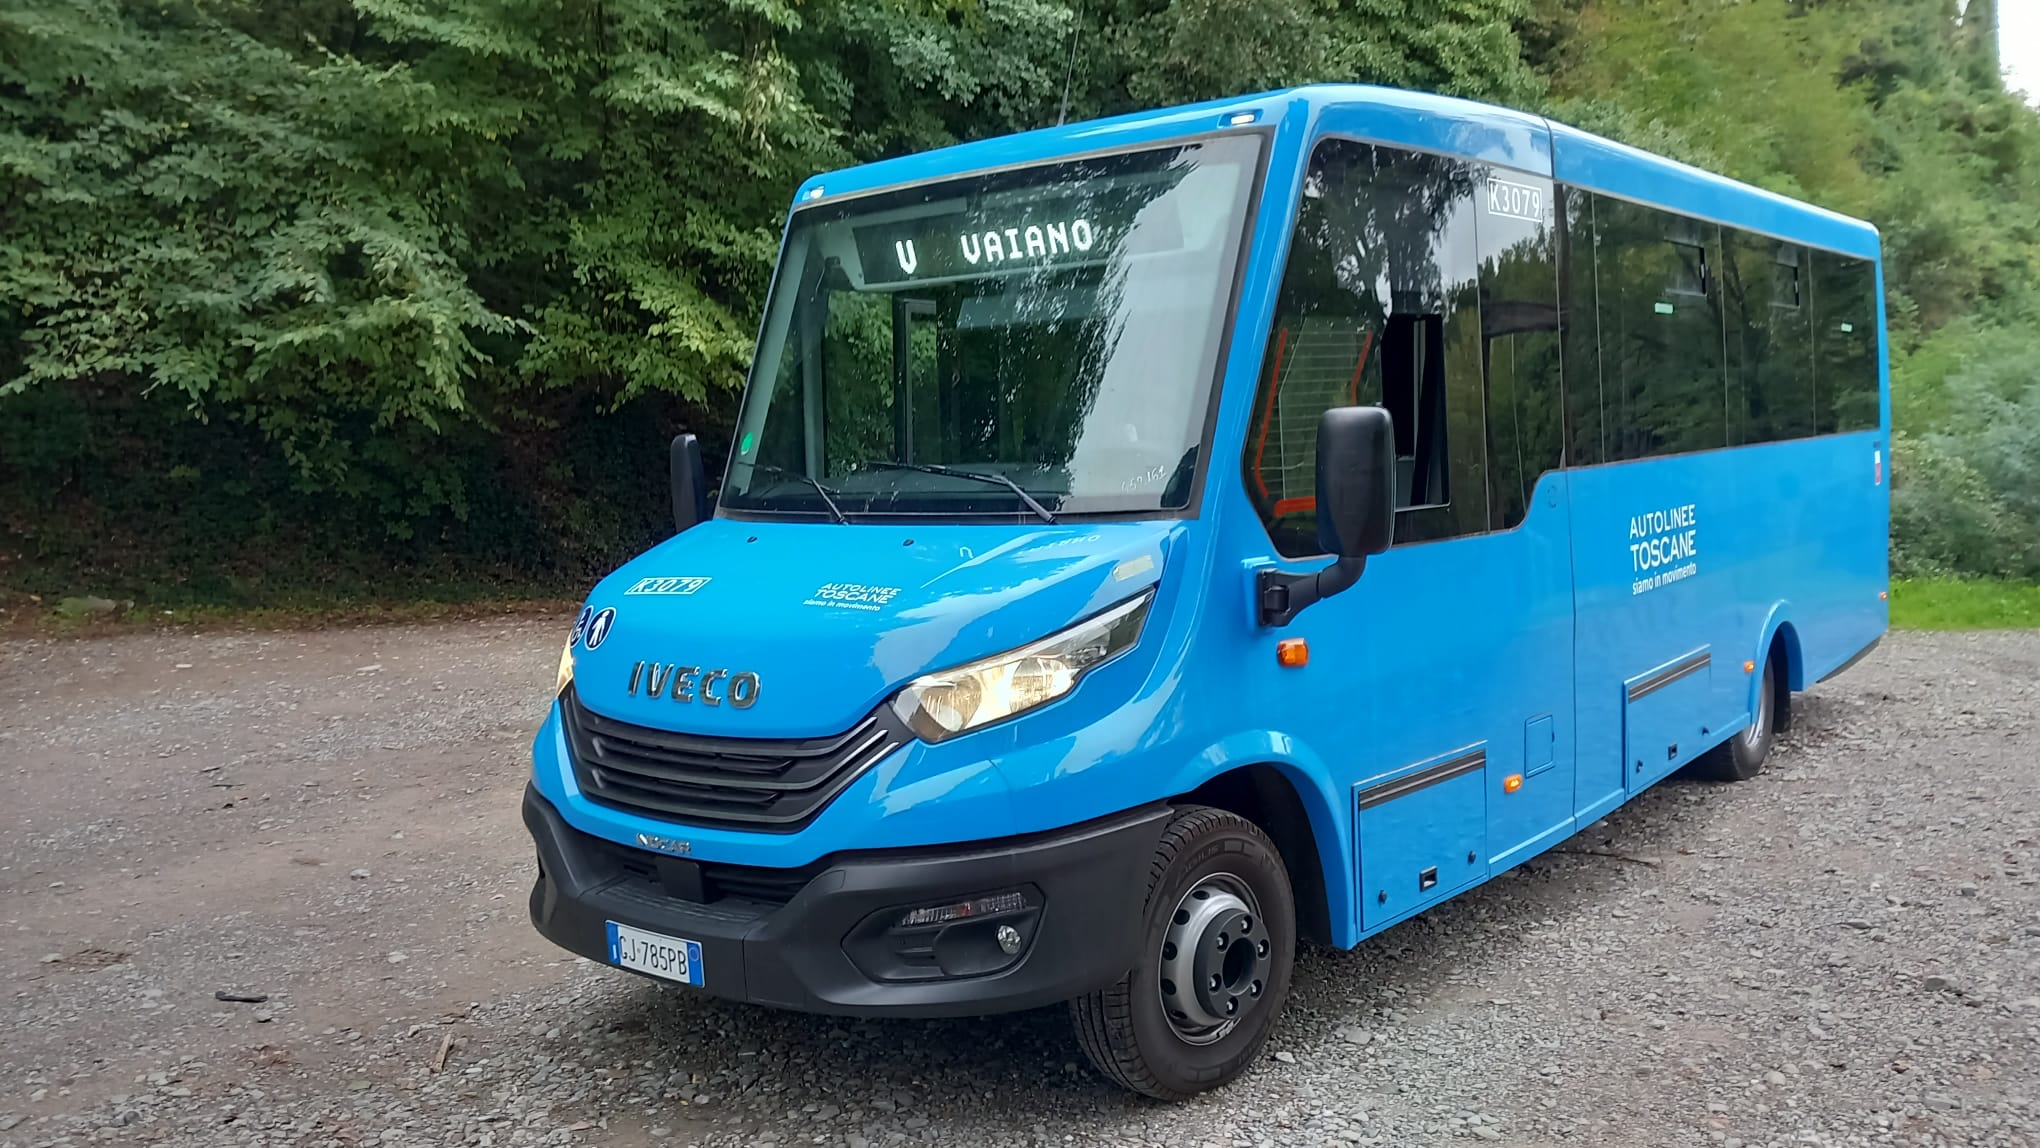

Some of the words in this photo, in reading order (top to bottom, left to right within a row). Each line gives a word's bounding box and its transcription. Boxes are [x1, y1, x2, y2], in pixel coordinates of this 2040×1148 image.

[1490, 183, 1540, 217] K3079
[960, 219, 1093, 264] VAIANO
[1629, 504, 1696, 540] AUTOLINEE
[1629, 529, 1697, 572] TOSCANE
[630, 579, 704, 593] K3079
[820, 583, 902, 596] AUTOLINEE
[1632, 577, 1653, 596] siamo
[1654, 571, 1661, 588] in
[1662, 561, 1697, 585] movimento
[814, 589, 894, 604] TOSCANE
[628, 660, 763, 710] IVECO
